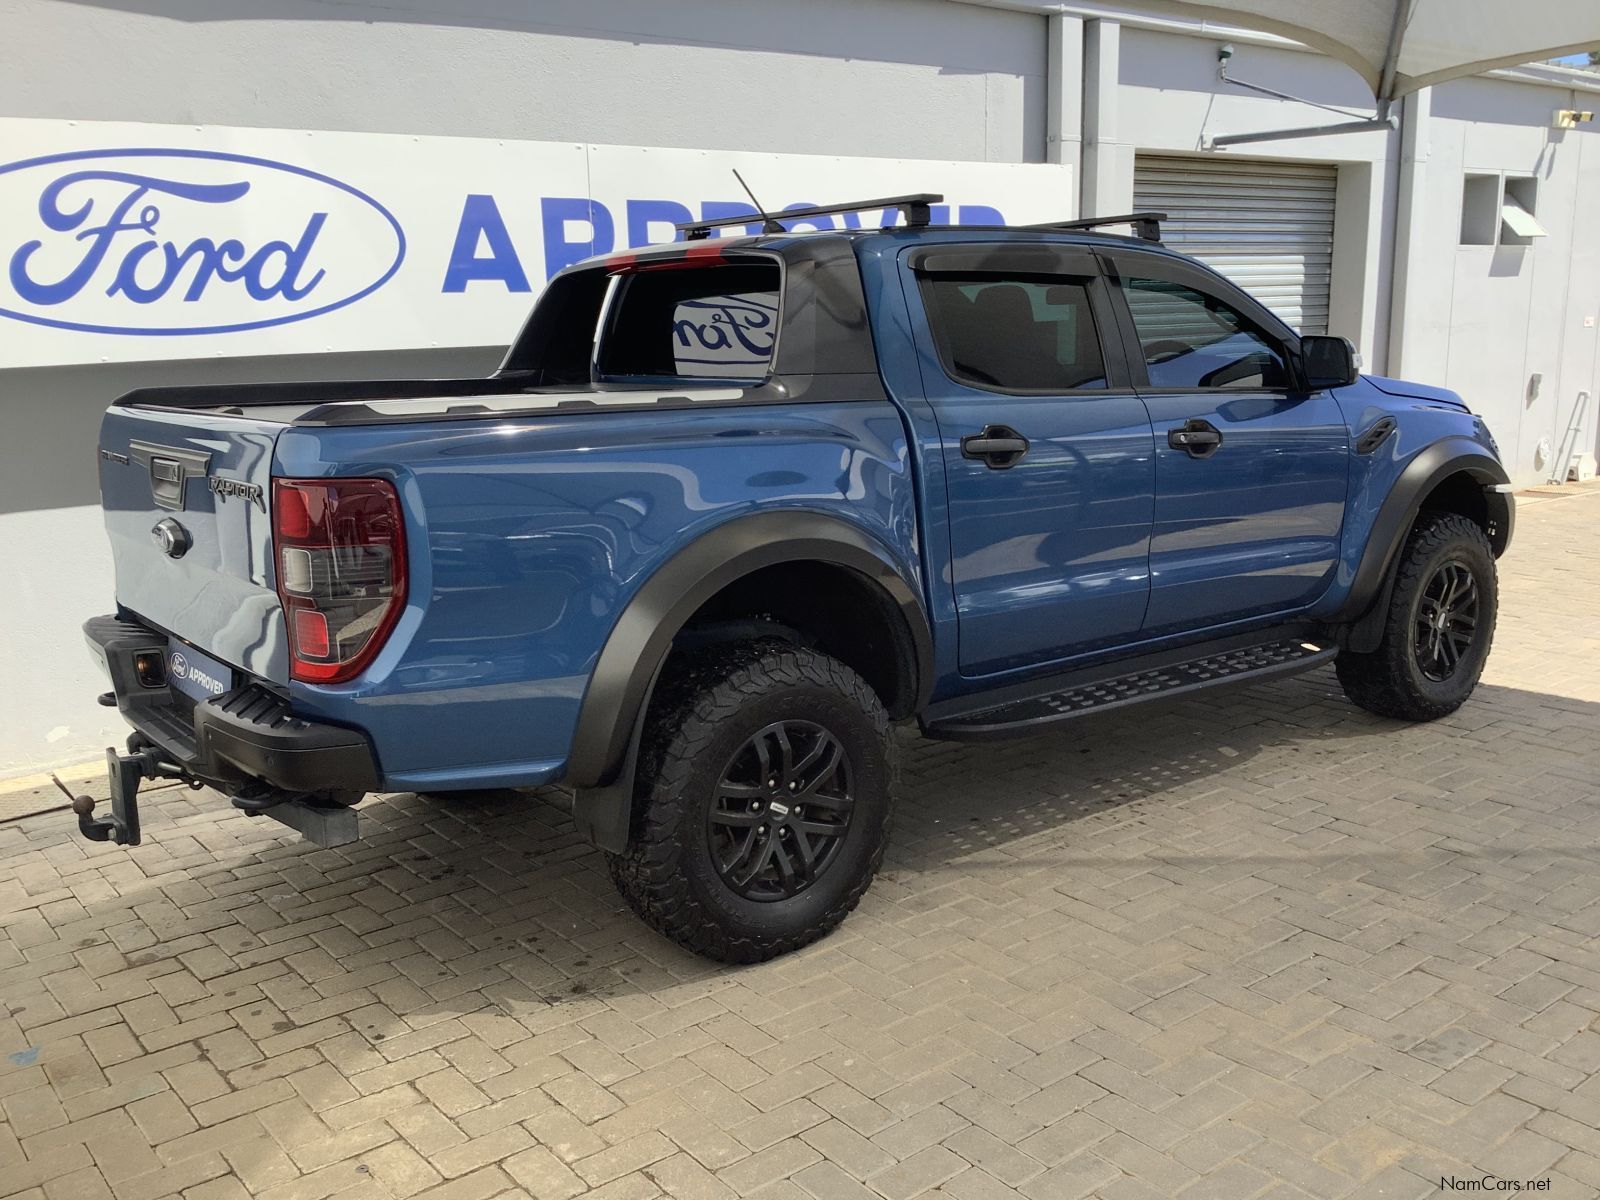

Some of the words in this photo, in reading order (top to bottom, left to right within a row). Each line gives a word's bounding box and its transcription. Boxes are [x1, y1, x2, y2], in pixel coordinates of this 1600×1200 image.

[9, 170, 329, 306] Ford
[208, 475, 265, 508] RAPTOR
[171, 653, 187, 677] Ford
[188, 666, 224, 694] APPROVED
